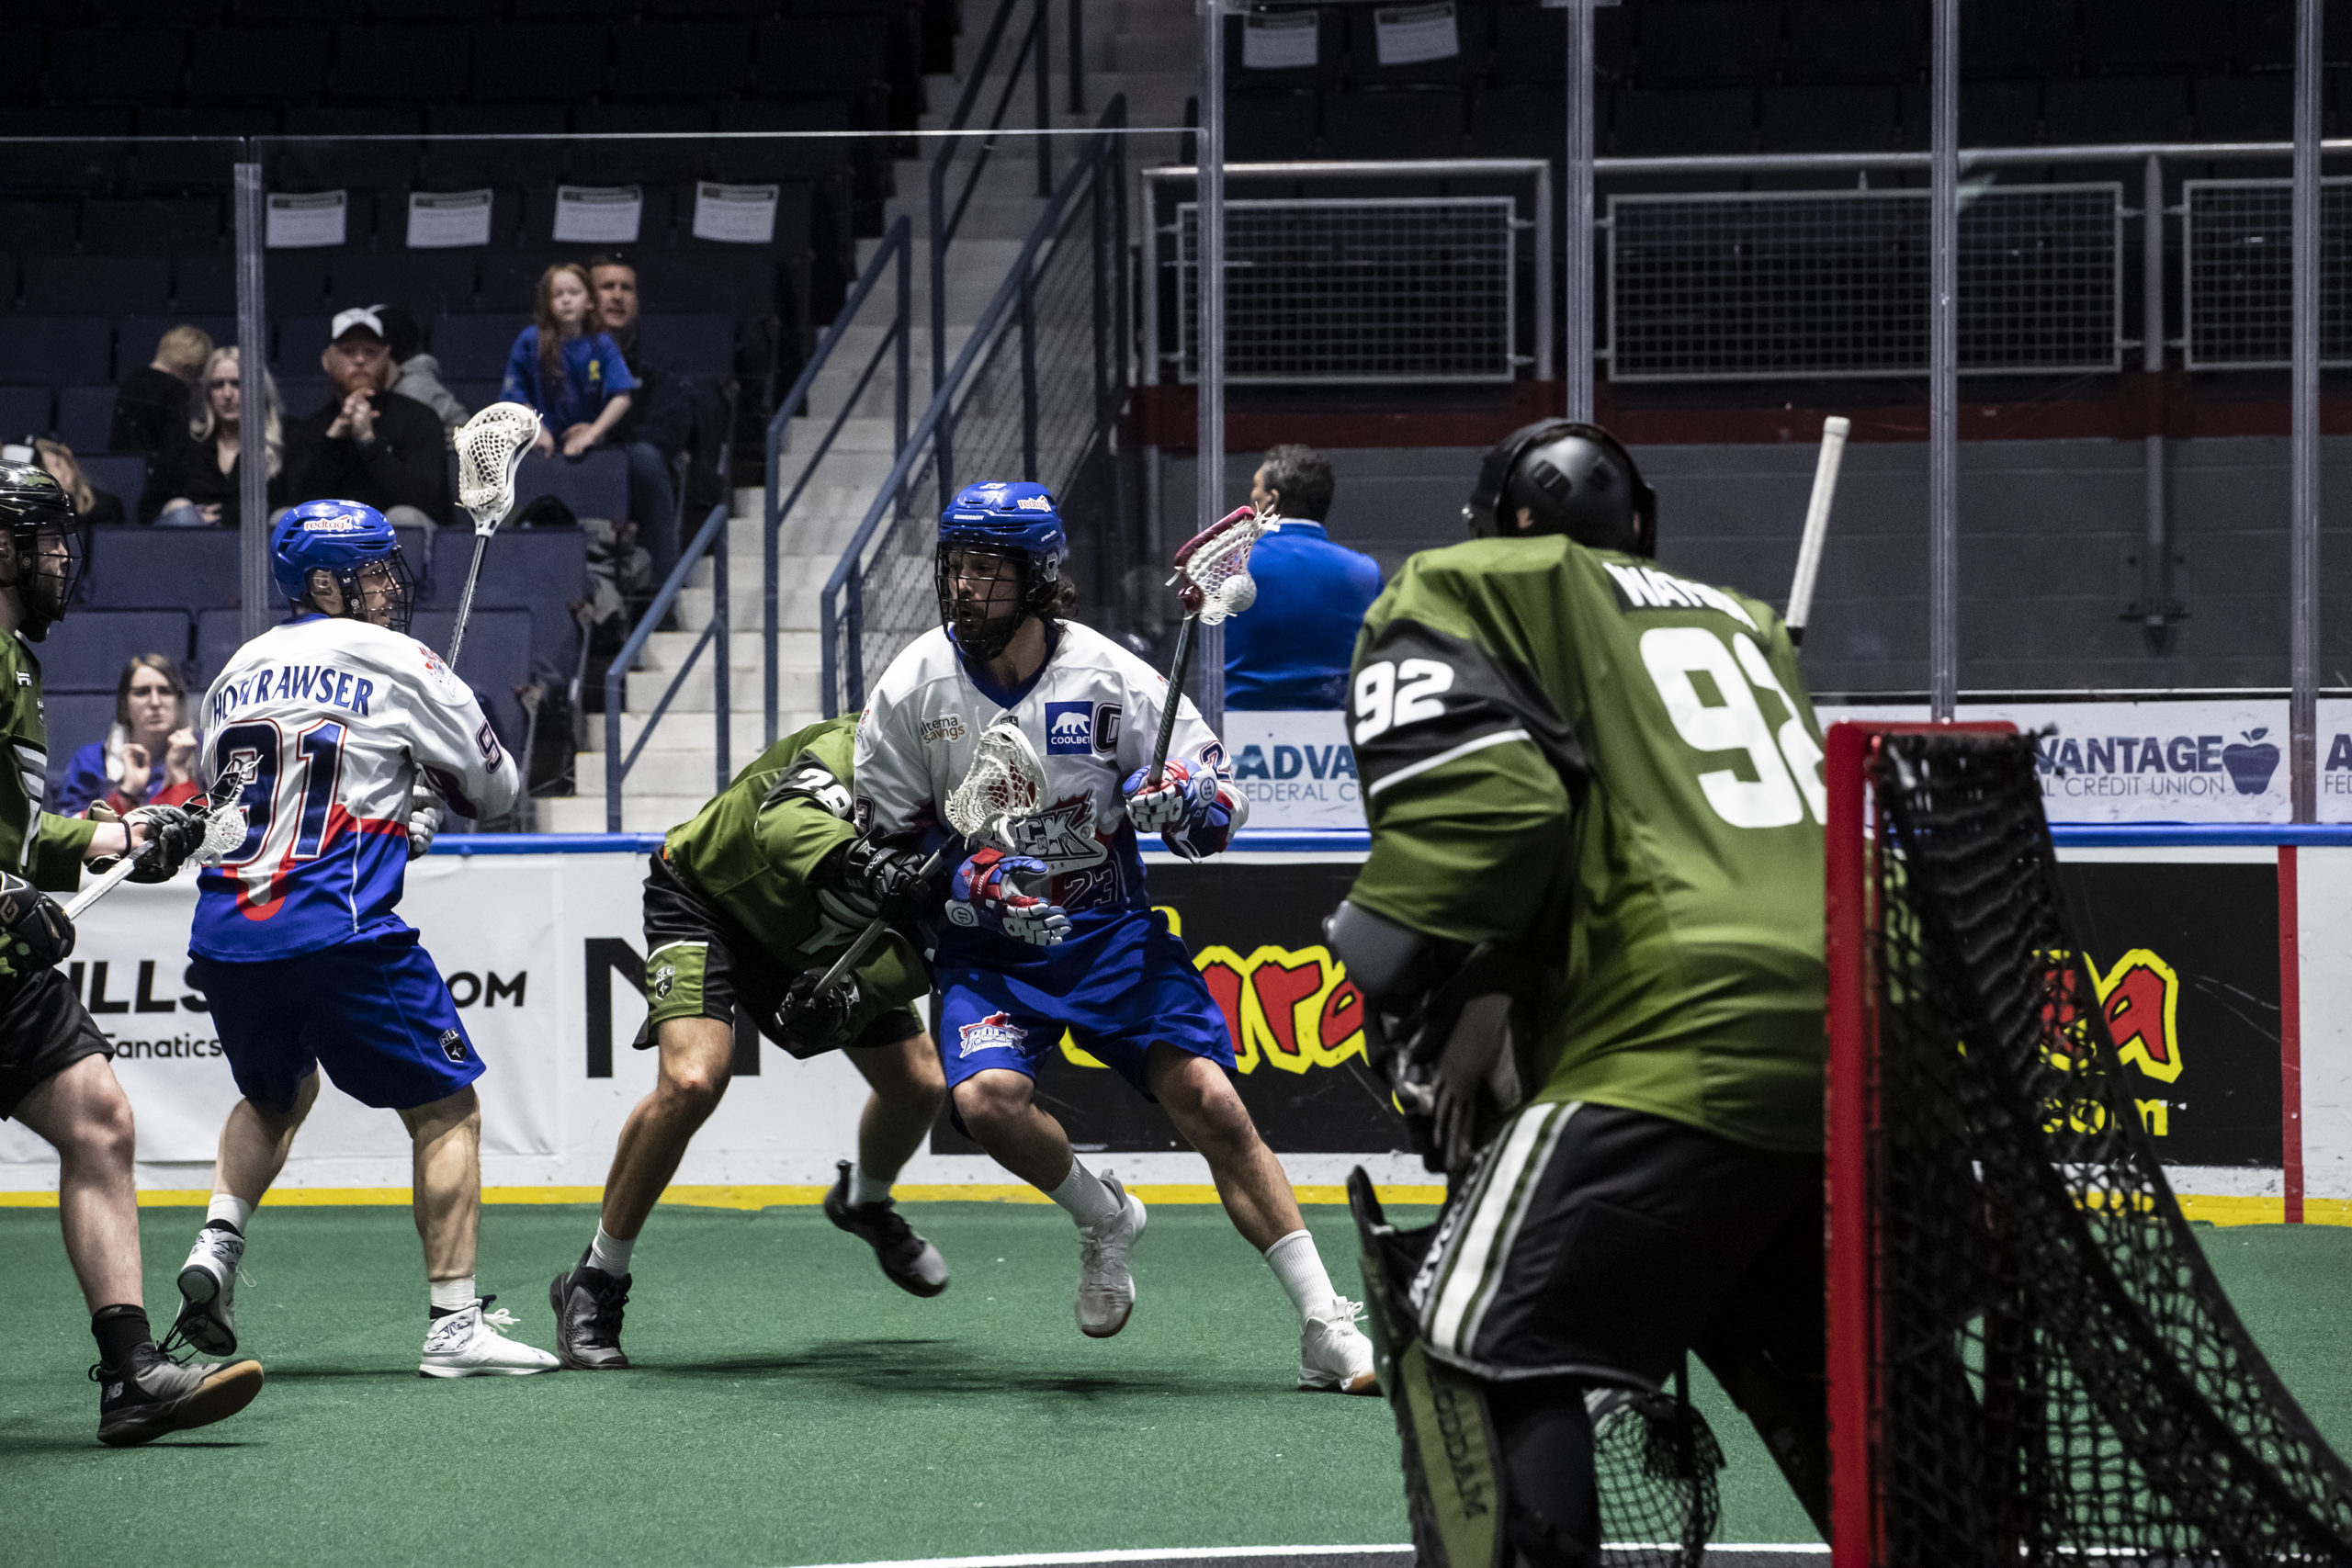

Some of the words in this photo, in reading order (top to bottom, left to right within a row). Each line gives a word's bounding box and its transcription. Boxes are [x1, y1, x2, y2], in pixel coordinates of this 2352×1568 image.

[305, 520, 345, 531] redtag
[1354, 658, 1454, 746] 92
[201, 716, 348, 868] 91
[2064, 775, 2142, 797] CREDIT
[2151, 774, 2225, 797] UNION
[1061, 860, 1119, 912] 23
[441, 1029, 459, 1044] NLL
